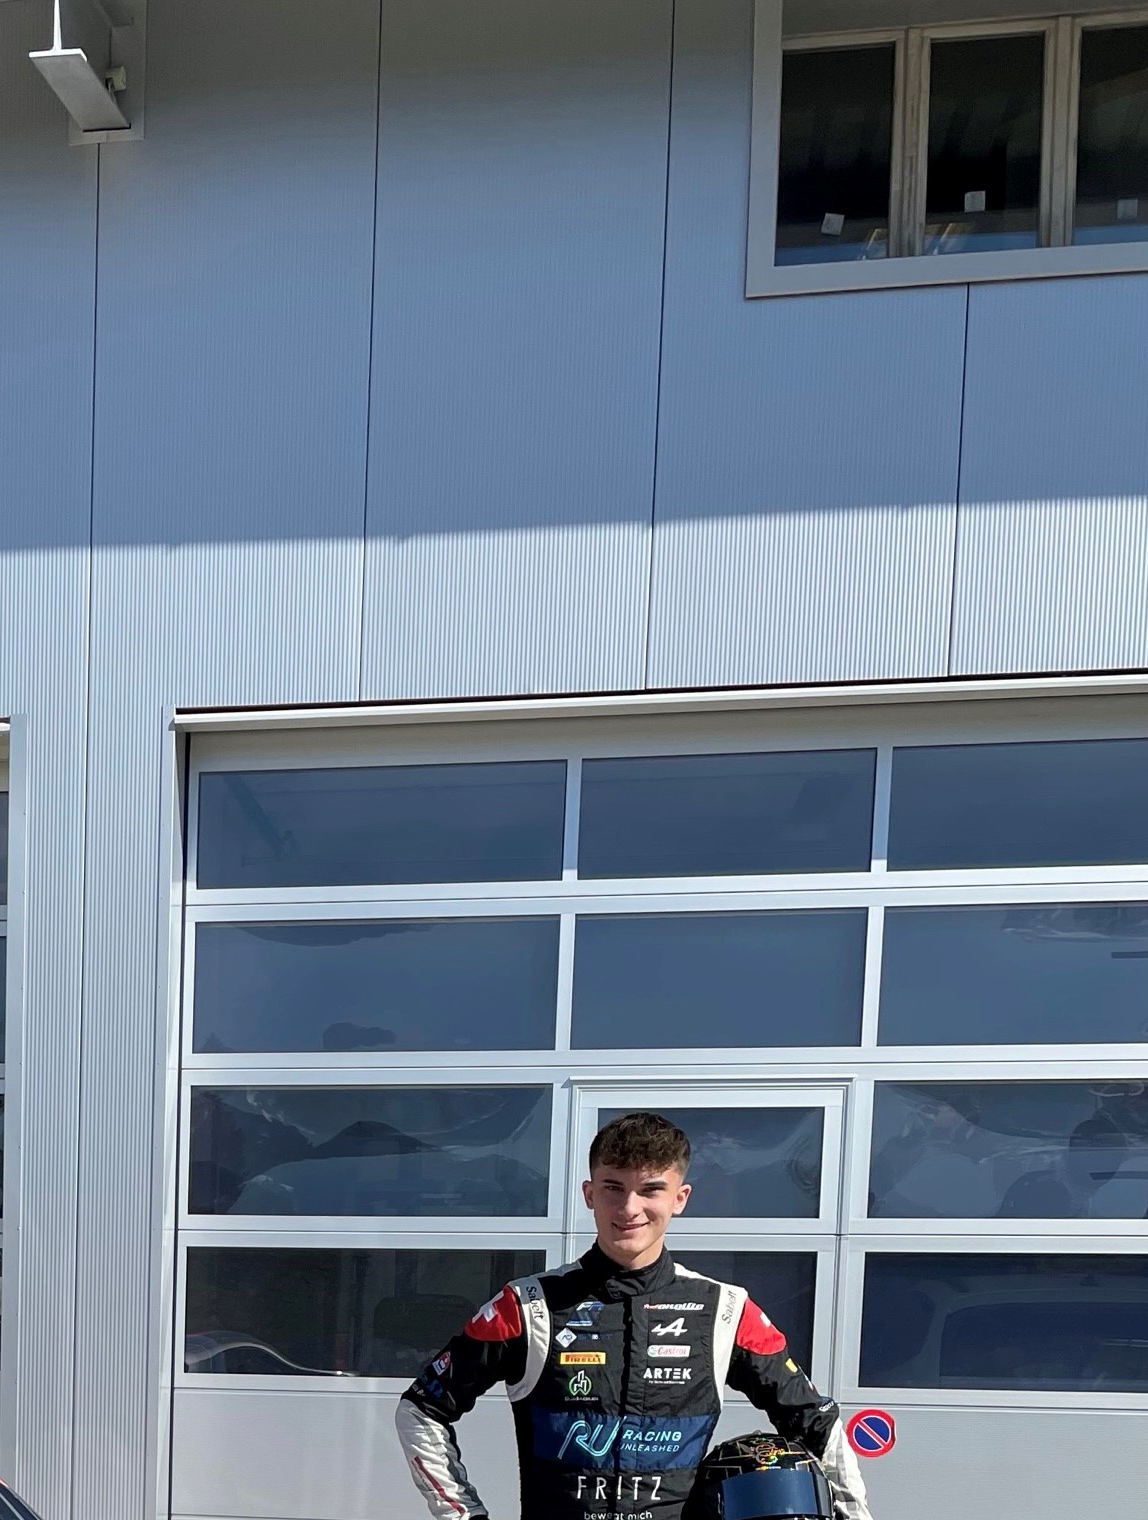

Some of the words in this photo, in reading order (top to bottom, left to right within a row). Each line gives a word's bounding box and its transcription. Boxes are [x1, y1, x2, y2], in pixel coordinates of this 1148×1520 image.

[526, 1286, 544, 1320] Sabelt
[721, 1290, 737, 1325] Sabelt
[657, 1347, 687, 1356] Castrol
[564, 1354, 602, 1363] PIRELLI
[643, 1367, 692, 1380] ARTEK
[622, 1429, 682, 1442] RACING
[627, 1510, 653, 1520] mich
